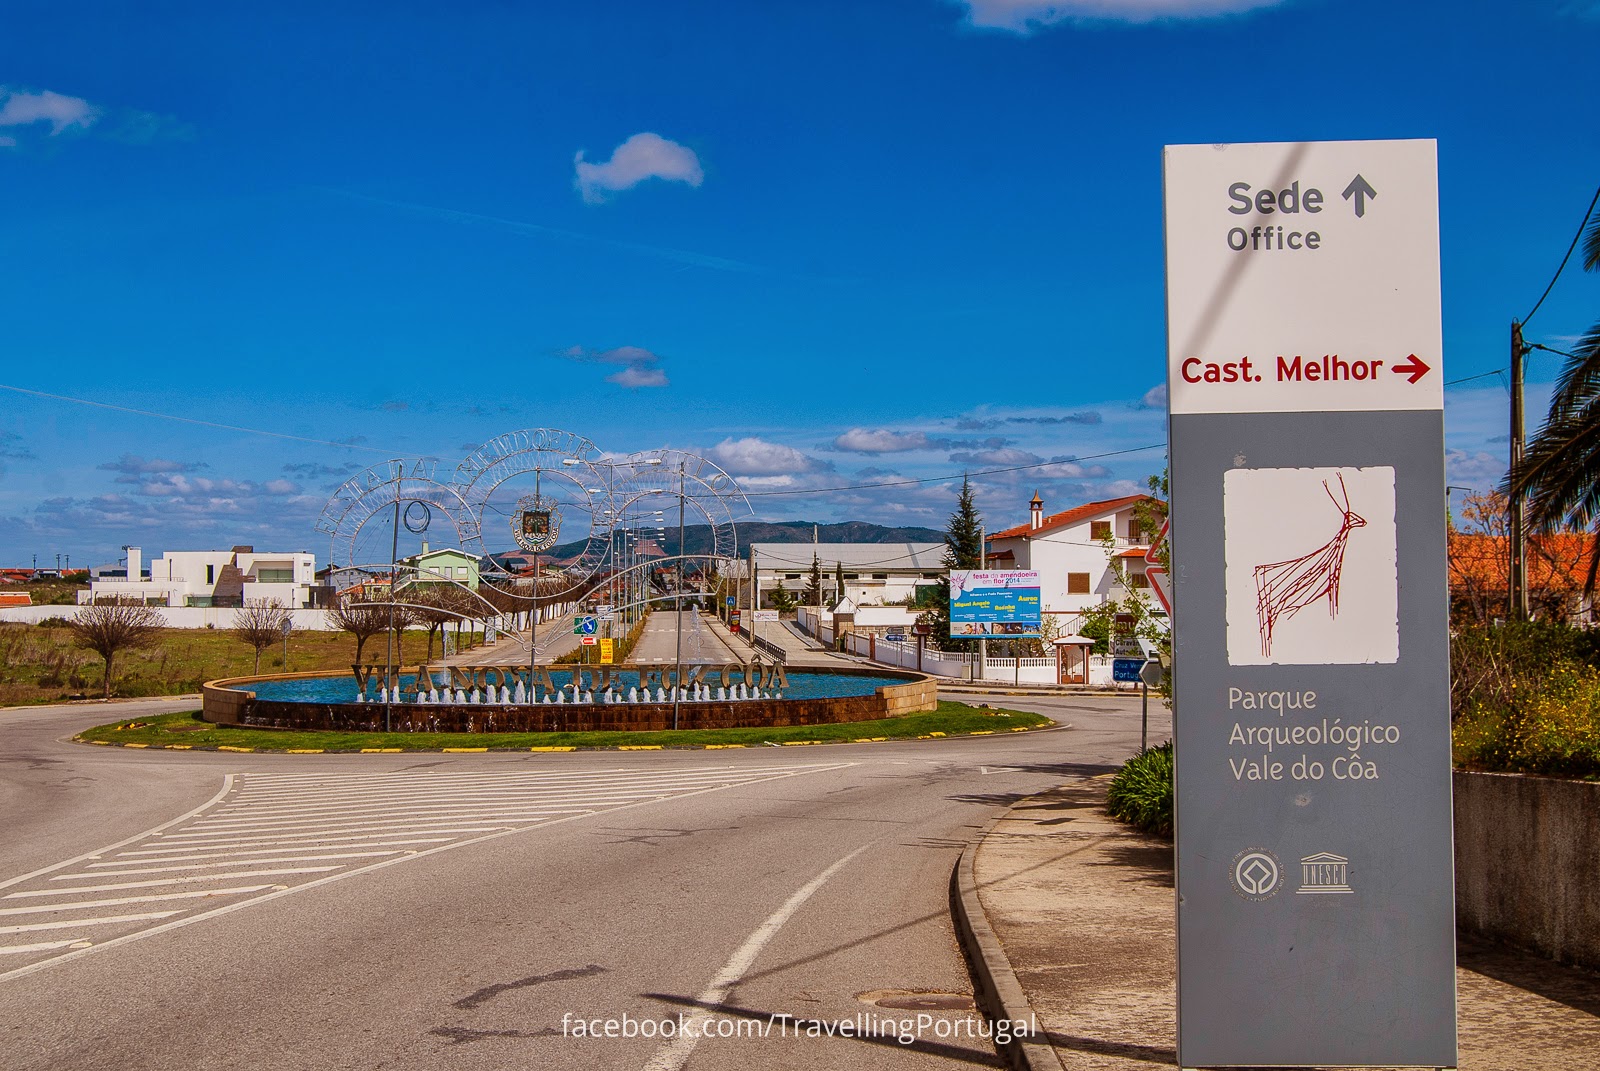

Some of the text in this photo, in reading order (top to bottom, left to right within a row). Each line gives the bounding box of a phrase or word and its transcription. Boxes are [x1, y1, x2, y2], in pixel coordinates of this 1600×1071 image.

[1227, 180, 1324, 215] Sede
[1227, 226, 1321, 251] Office
[1181, 354, 1384, 383] Cast. Melhor
[1005, 577, 1021, 585] 2014
[351, 653, 790, 695] VILA NOVA DE FOZ CÔA
[1114, 661, 1128, 670] Cruz
[1114, 671, 1140, 680] Portug
[1228, 687, 1317, 717] Parque
[1228, 718, 1400, 752] Arqueológico
[1228, 752, 1380, 781] Vale do Côa
[1303, 864, 1347, 886] UNESCO
